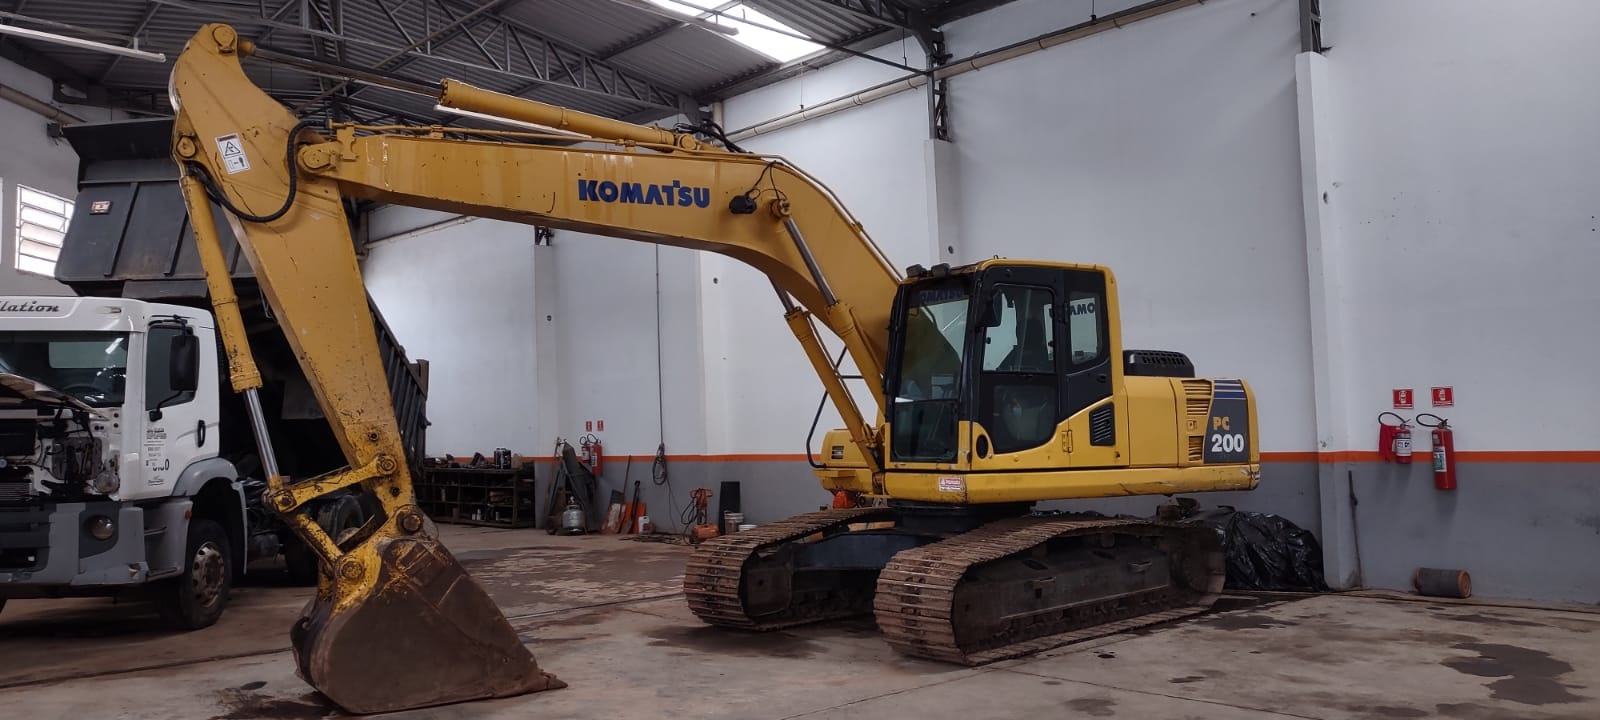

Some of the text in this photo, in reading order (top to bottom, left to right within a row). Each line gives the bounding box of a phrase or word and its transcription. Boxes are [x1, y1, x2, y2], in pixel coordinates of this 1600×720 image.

[578, 179, 710, 208] KOMATSU
[0, 300, 59, 312] lation
[1212, 416, 1230, 431] PC
[1211, 433, 1245, 453] 200
